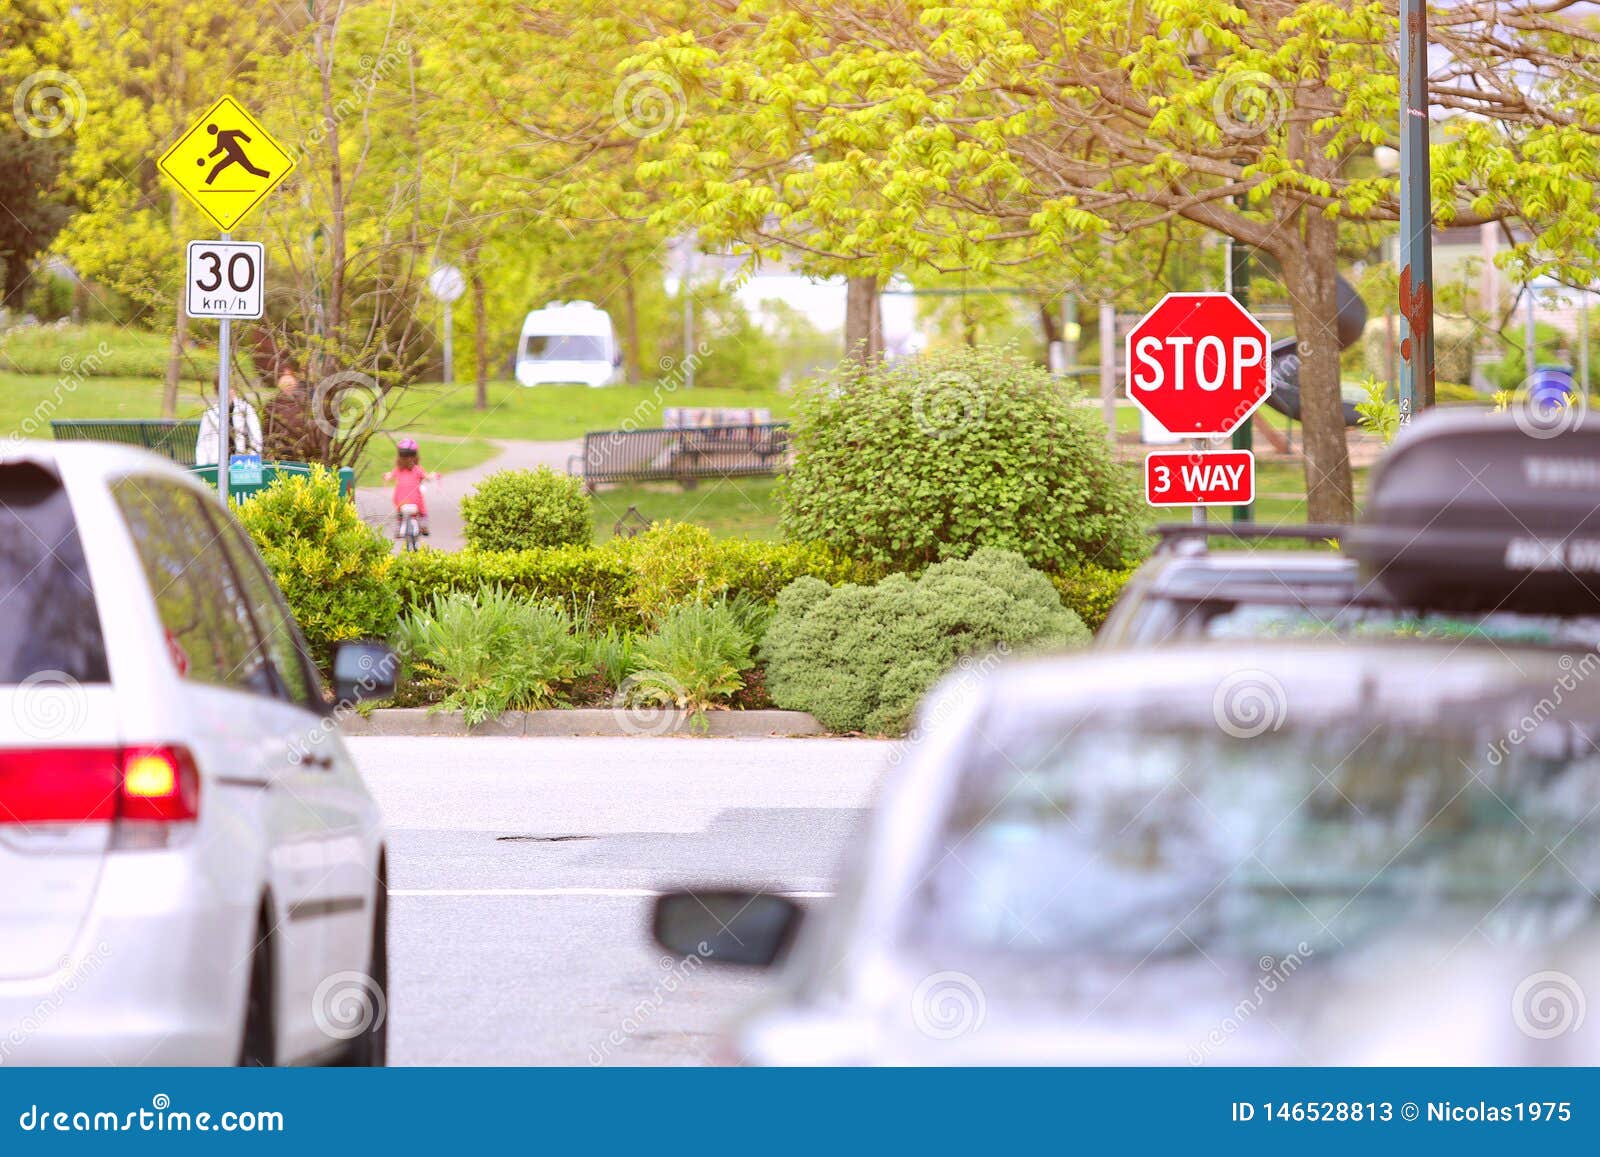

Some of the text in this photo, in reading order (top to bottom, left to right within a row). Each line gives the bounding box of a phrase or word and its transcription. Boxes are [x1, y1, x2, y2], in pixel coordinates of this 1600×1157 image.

[196, 251, 255, 293] 30
[202, 296, 247, 312] km/h
[1134, 335, 1263, 392] STOP
[1154, 464, 1245, 493] 3 WAY
